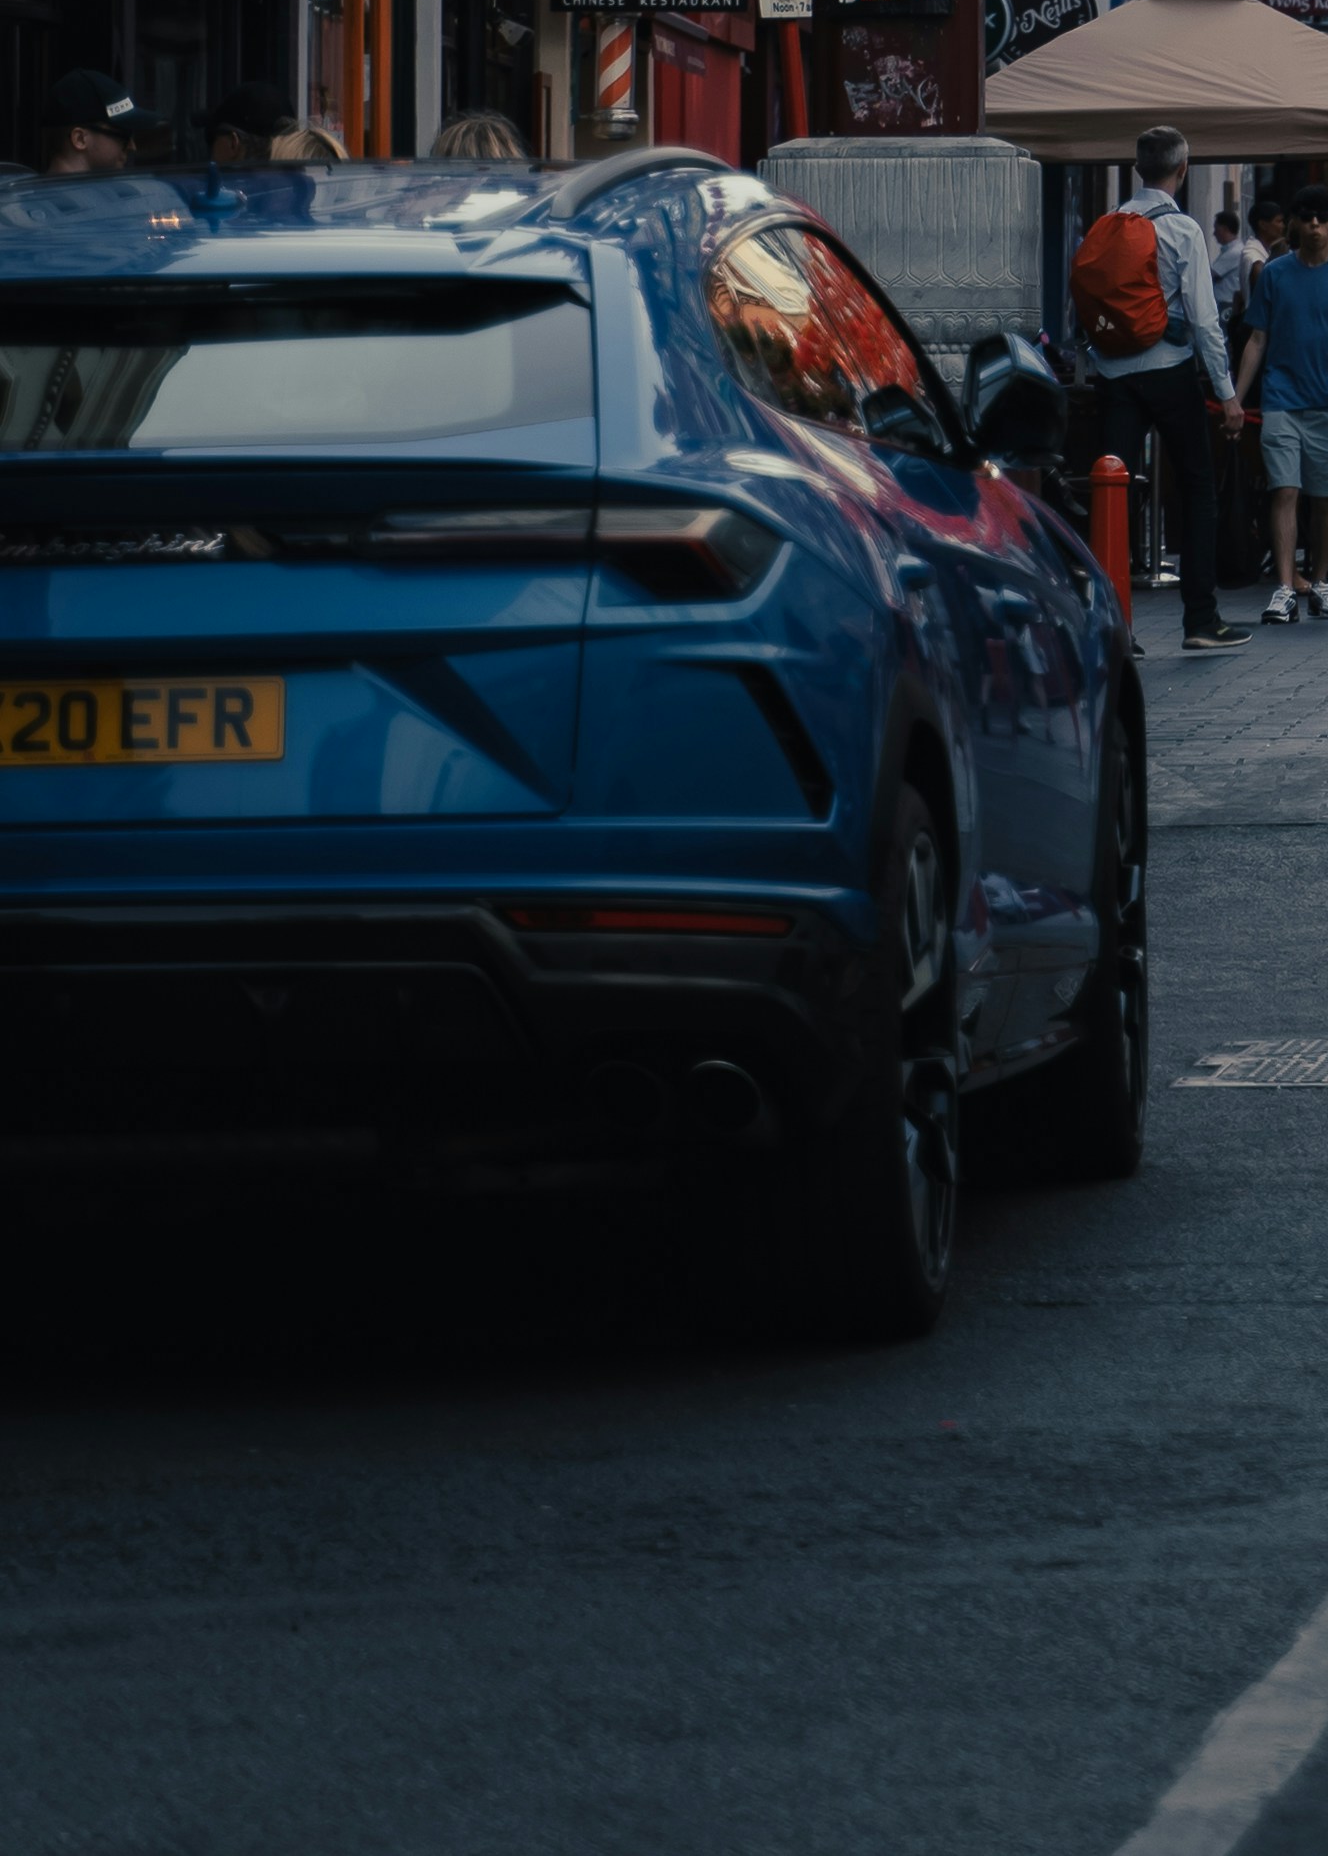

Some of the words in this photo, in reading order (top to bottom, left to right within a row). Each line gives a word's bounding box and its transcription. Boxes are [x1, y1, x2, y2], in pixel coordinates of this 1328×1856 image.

[773, 3, 794, 13] Noon
[0, 690, 98, 752] 20
[121, 688, 254, 750] EFR
